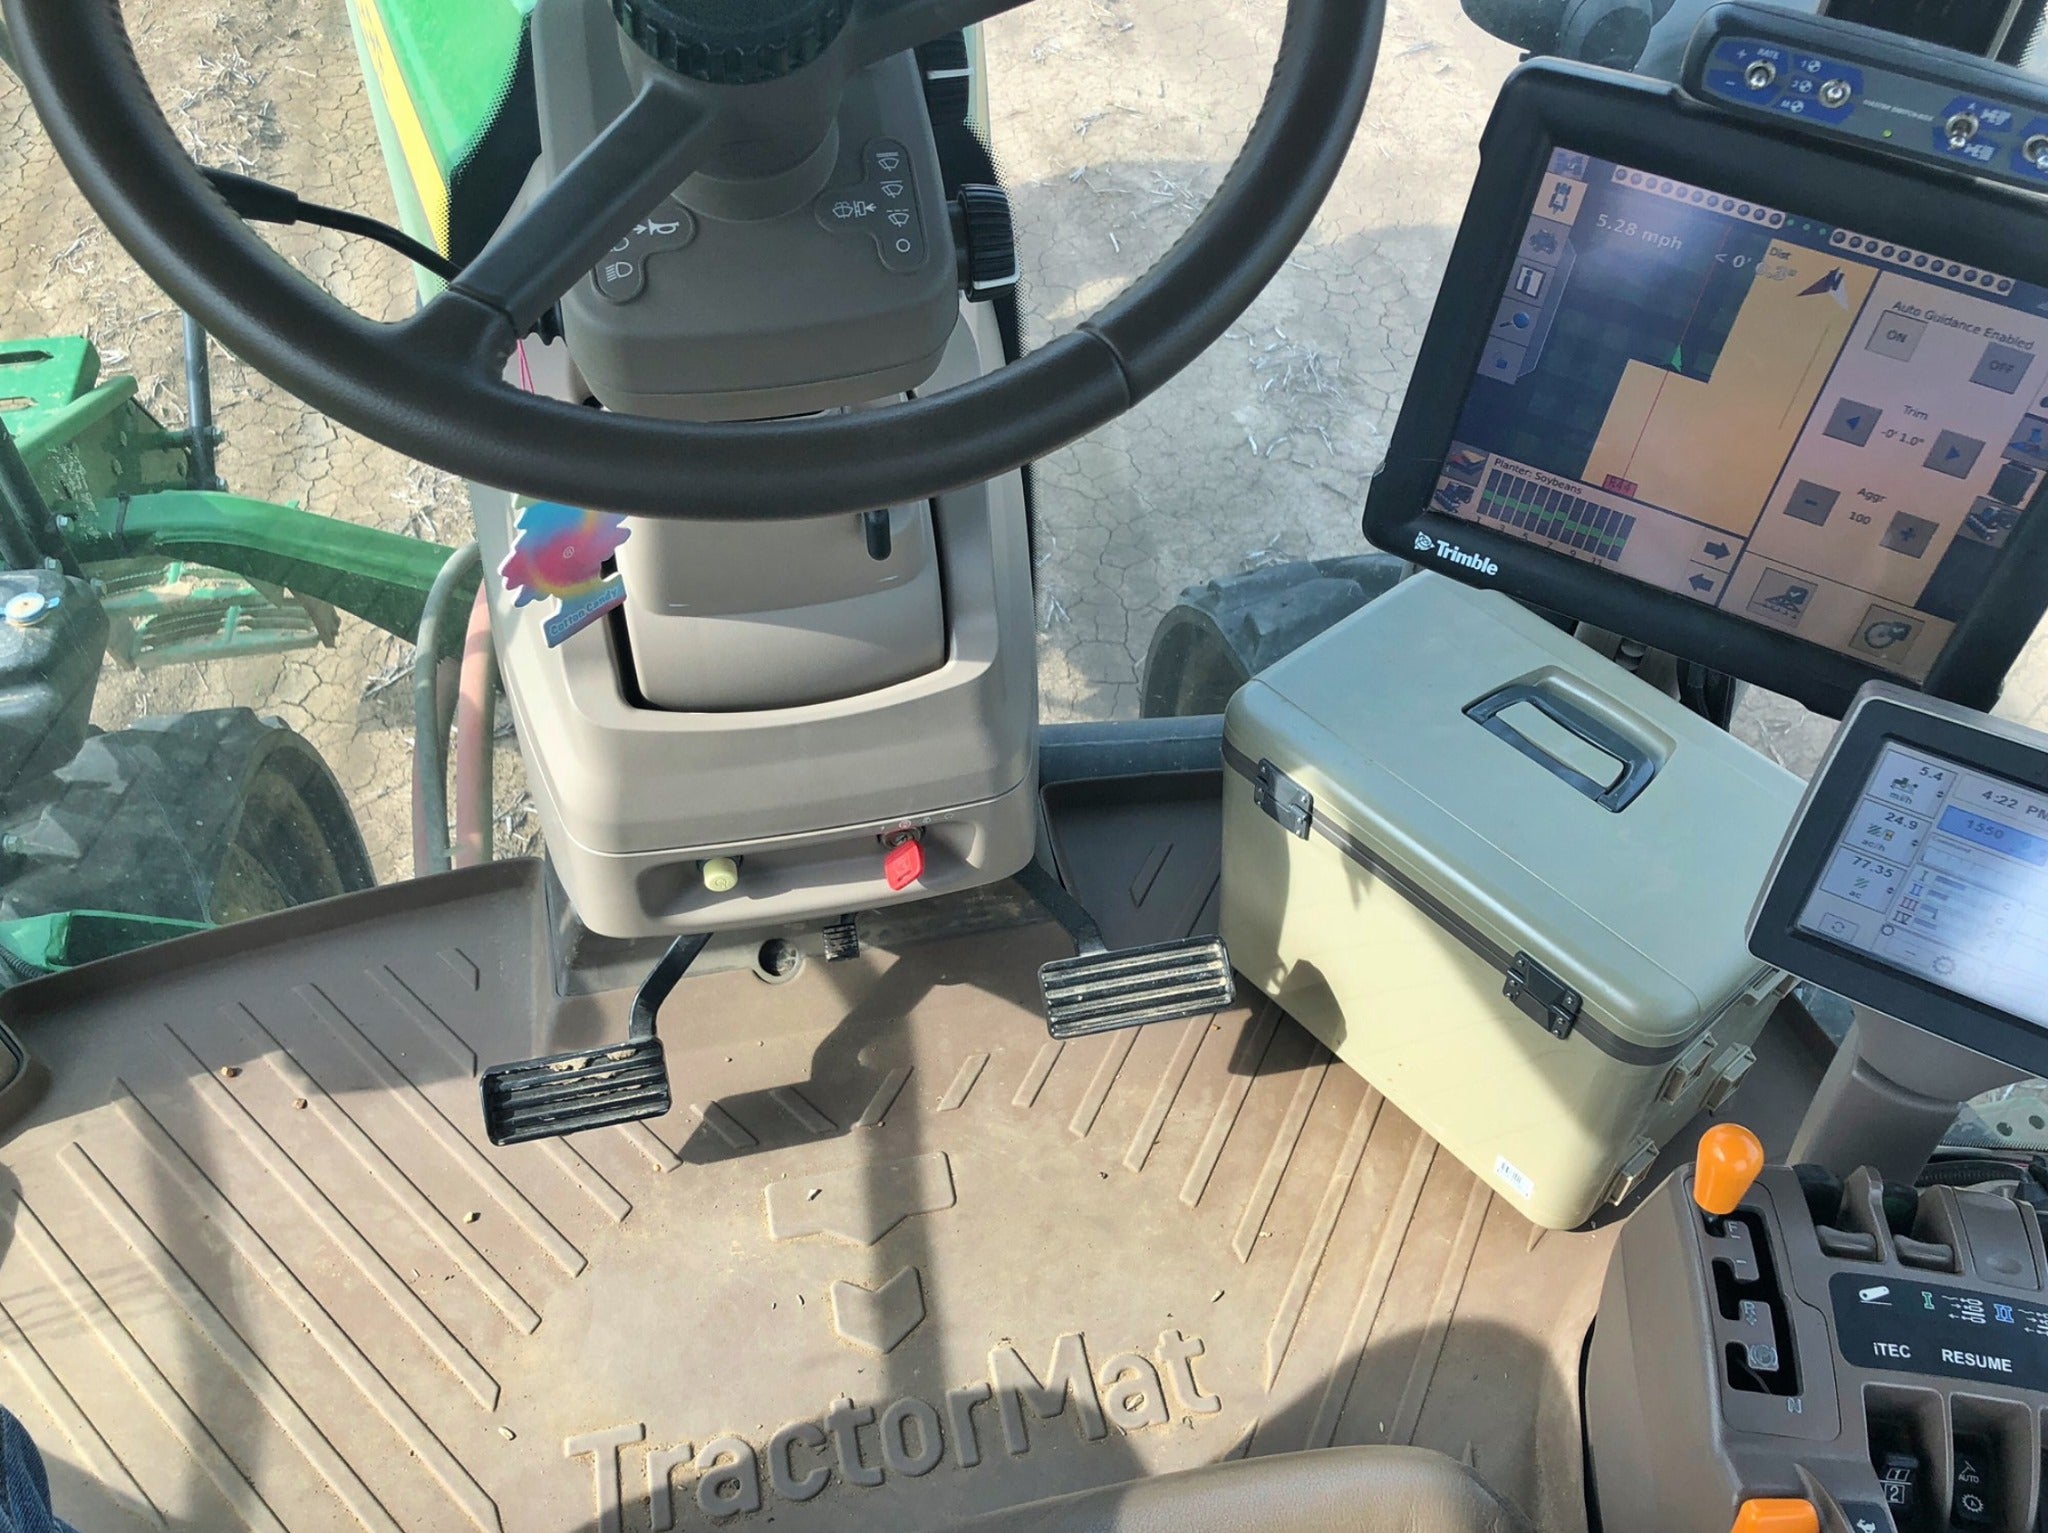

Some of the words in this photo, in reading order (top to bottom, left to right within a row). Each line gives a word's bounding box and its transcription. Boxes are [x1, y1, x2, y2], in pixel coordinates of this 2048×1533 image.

[1596, 213, 1638, 237] 5.28
[1641, 228, 1683, 251] mph
[1892, 301, 1921, 317] Auto
[1924, 309, 1982, 335] Guidance
[1983, 327, 2036, 350] Enabled
[1886, 330, 1908, 343] ON
[1989, 360, 2015, 374] OFF
[1903, 404, 1929, 421] Trim
[1494, 457, 1533, 478] Planter:
[1534, 472, 1583, 495] Soybeans
[1857, 487, 1887, 504] Aggr
[1848, 511, 1872, 525] 100
[1436, 539, 1499, 576] Trimble
[550, 609, 585, 636] Cotton
[585, 586, 619, 613] Candy
[1919, 766, 1944, 781] 5.4
[1982, 790, 2019, 809] 4:22
[2025, 804, 2048, 820] PM
[1884, 811, 1919, 831] 24.9
[1967, 819, 2005, 840] 1550
[1852, 856, 1895, 878] 77.35
[1873, 1342, 1912, 1359] iTEC
[1941, 1348, 2013, 1373] RESUME
[564, 1328, 1222, 1533] TractorMat
[1958, 1474, 1980, 1484] AUTO
